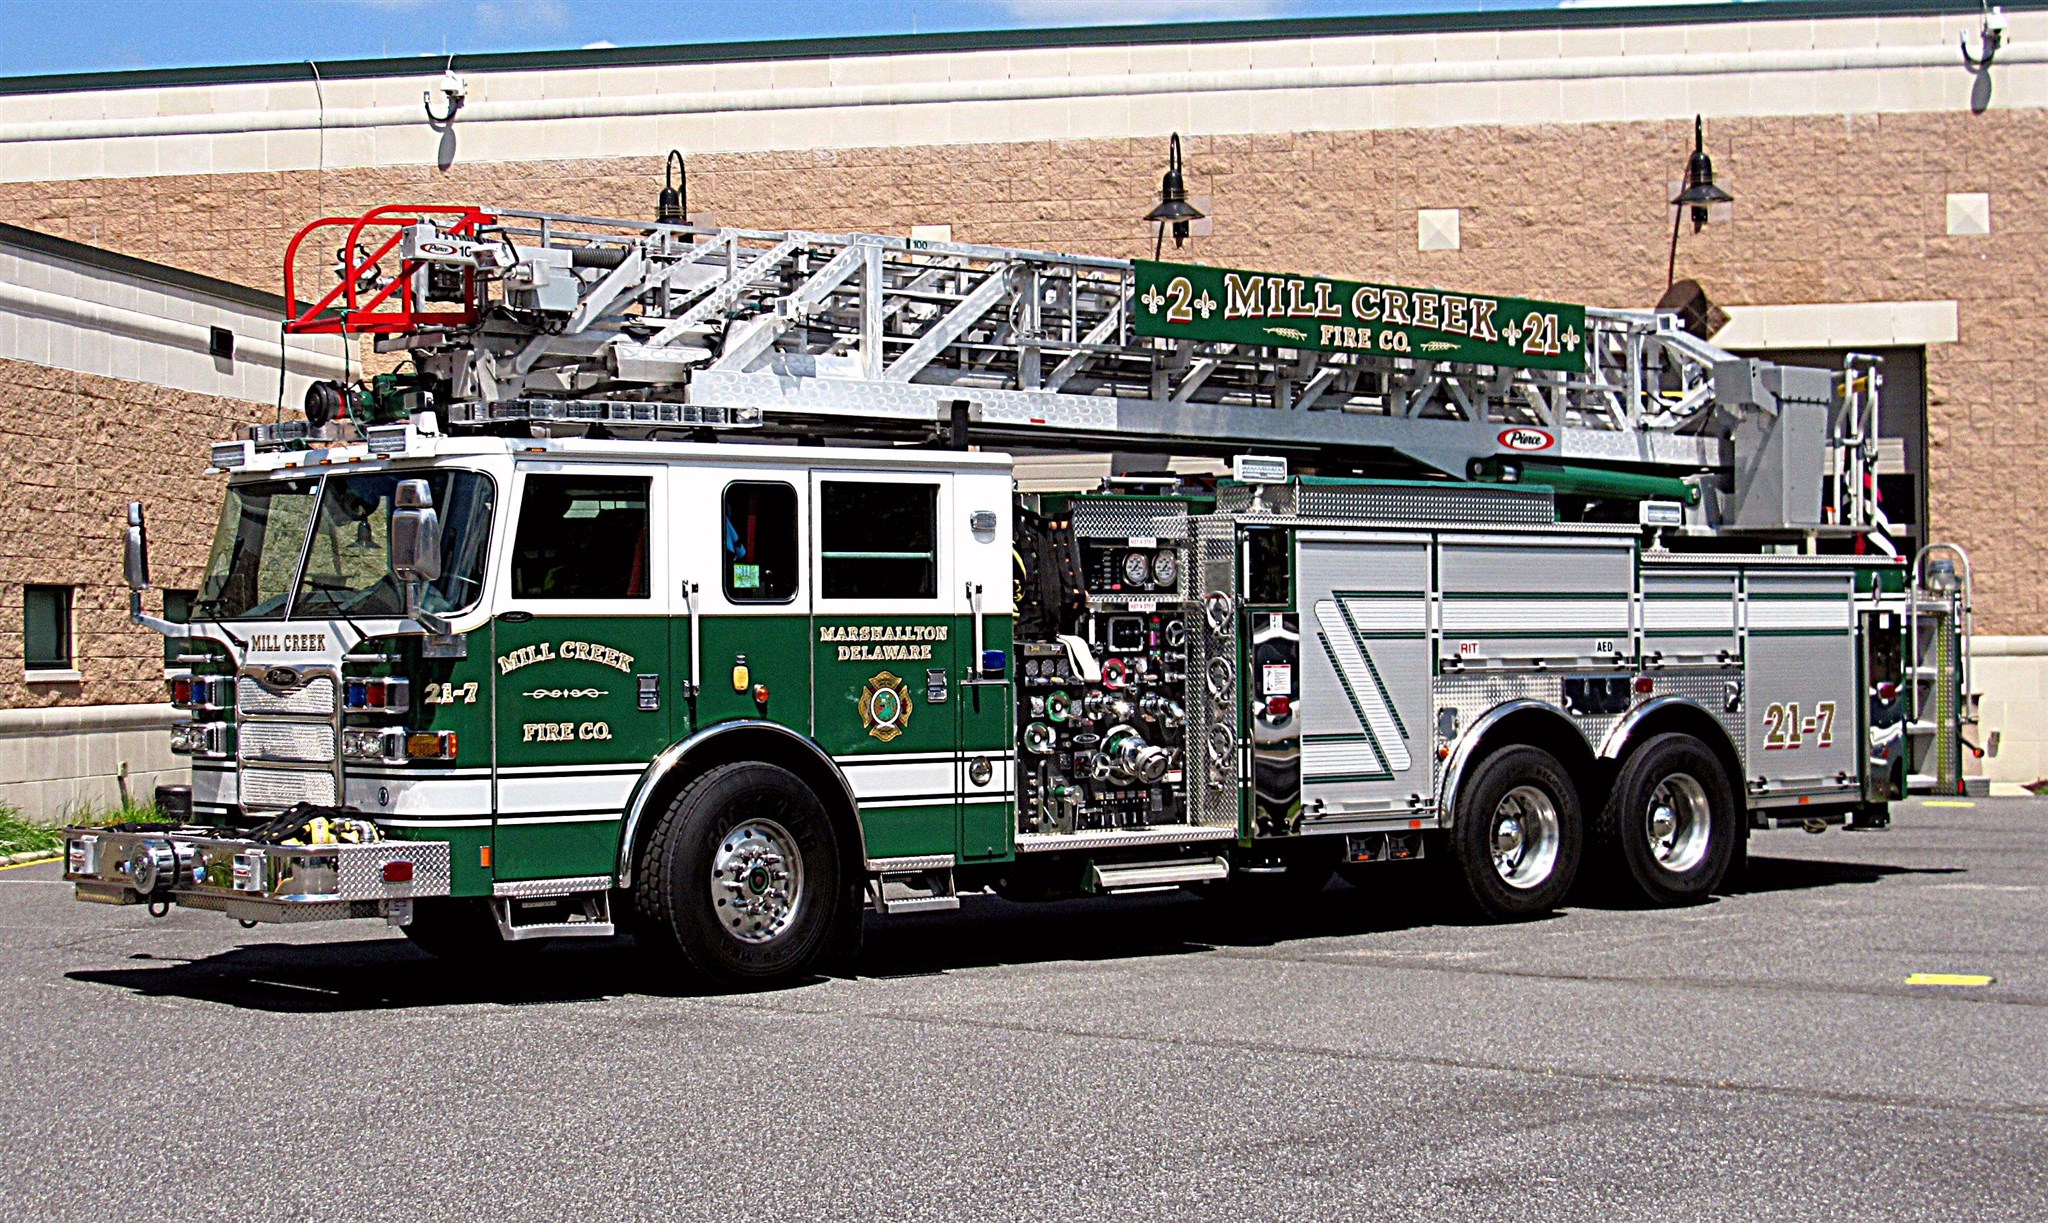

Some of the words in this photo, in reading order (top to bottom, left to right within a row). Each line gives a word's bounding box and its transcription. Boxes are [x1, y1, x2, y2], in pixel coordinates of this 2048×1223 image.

[913, 240, 928, 250] 100
[1166, 276, 1193, 324] 2
[1224, 273, 1342, 320] MILL
[1352, 287, 1498, 343] CREEK
[1522, 312, 1561, 356] 21
[1320, 324, 1371, 349] FIRE
[1379, 330, 1412, 353] CO.
[1510, 431, 1541, 446] Pierce
[820, 626, 948, 641] MARSHALLTON
[251, 634, 281, 652] MILL
[284, 634, 326, 652] CREEK
[1460, 643, 1479, 654] RIT
[1596, 641, 1613, 653] AED
[497, 642, 556, 675] MILL
[560, 641, 635, 673] CREEK
[838, 645, 932, 660] DELAWARE
[424, 682, 479, 704] 21-7
[523, 722, 575, 742] FIRE
[579, 721, 613, 740] CO.
[1763, 701, 1837, 751] 21-7
